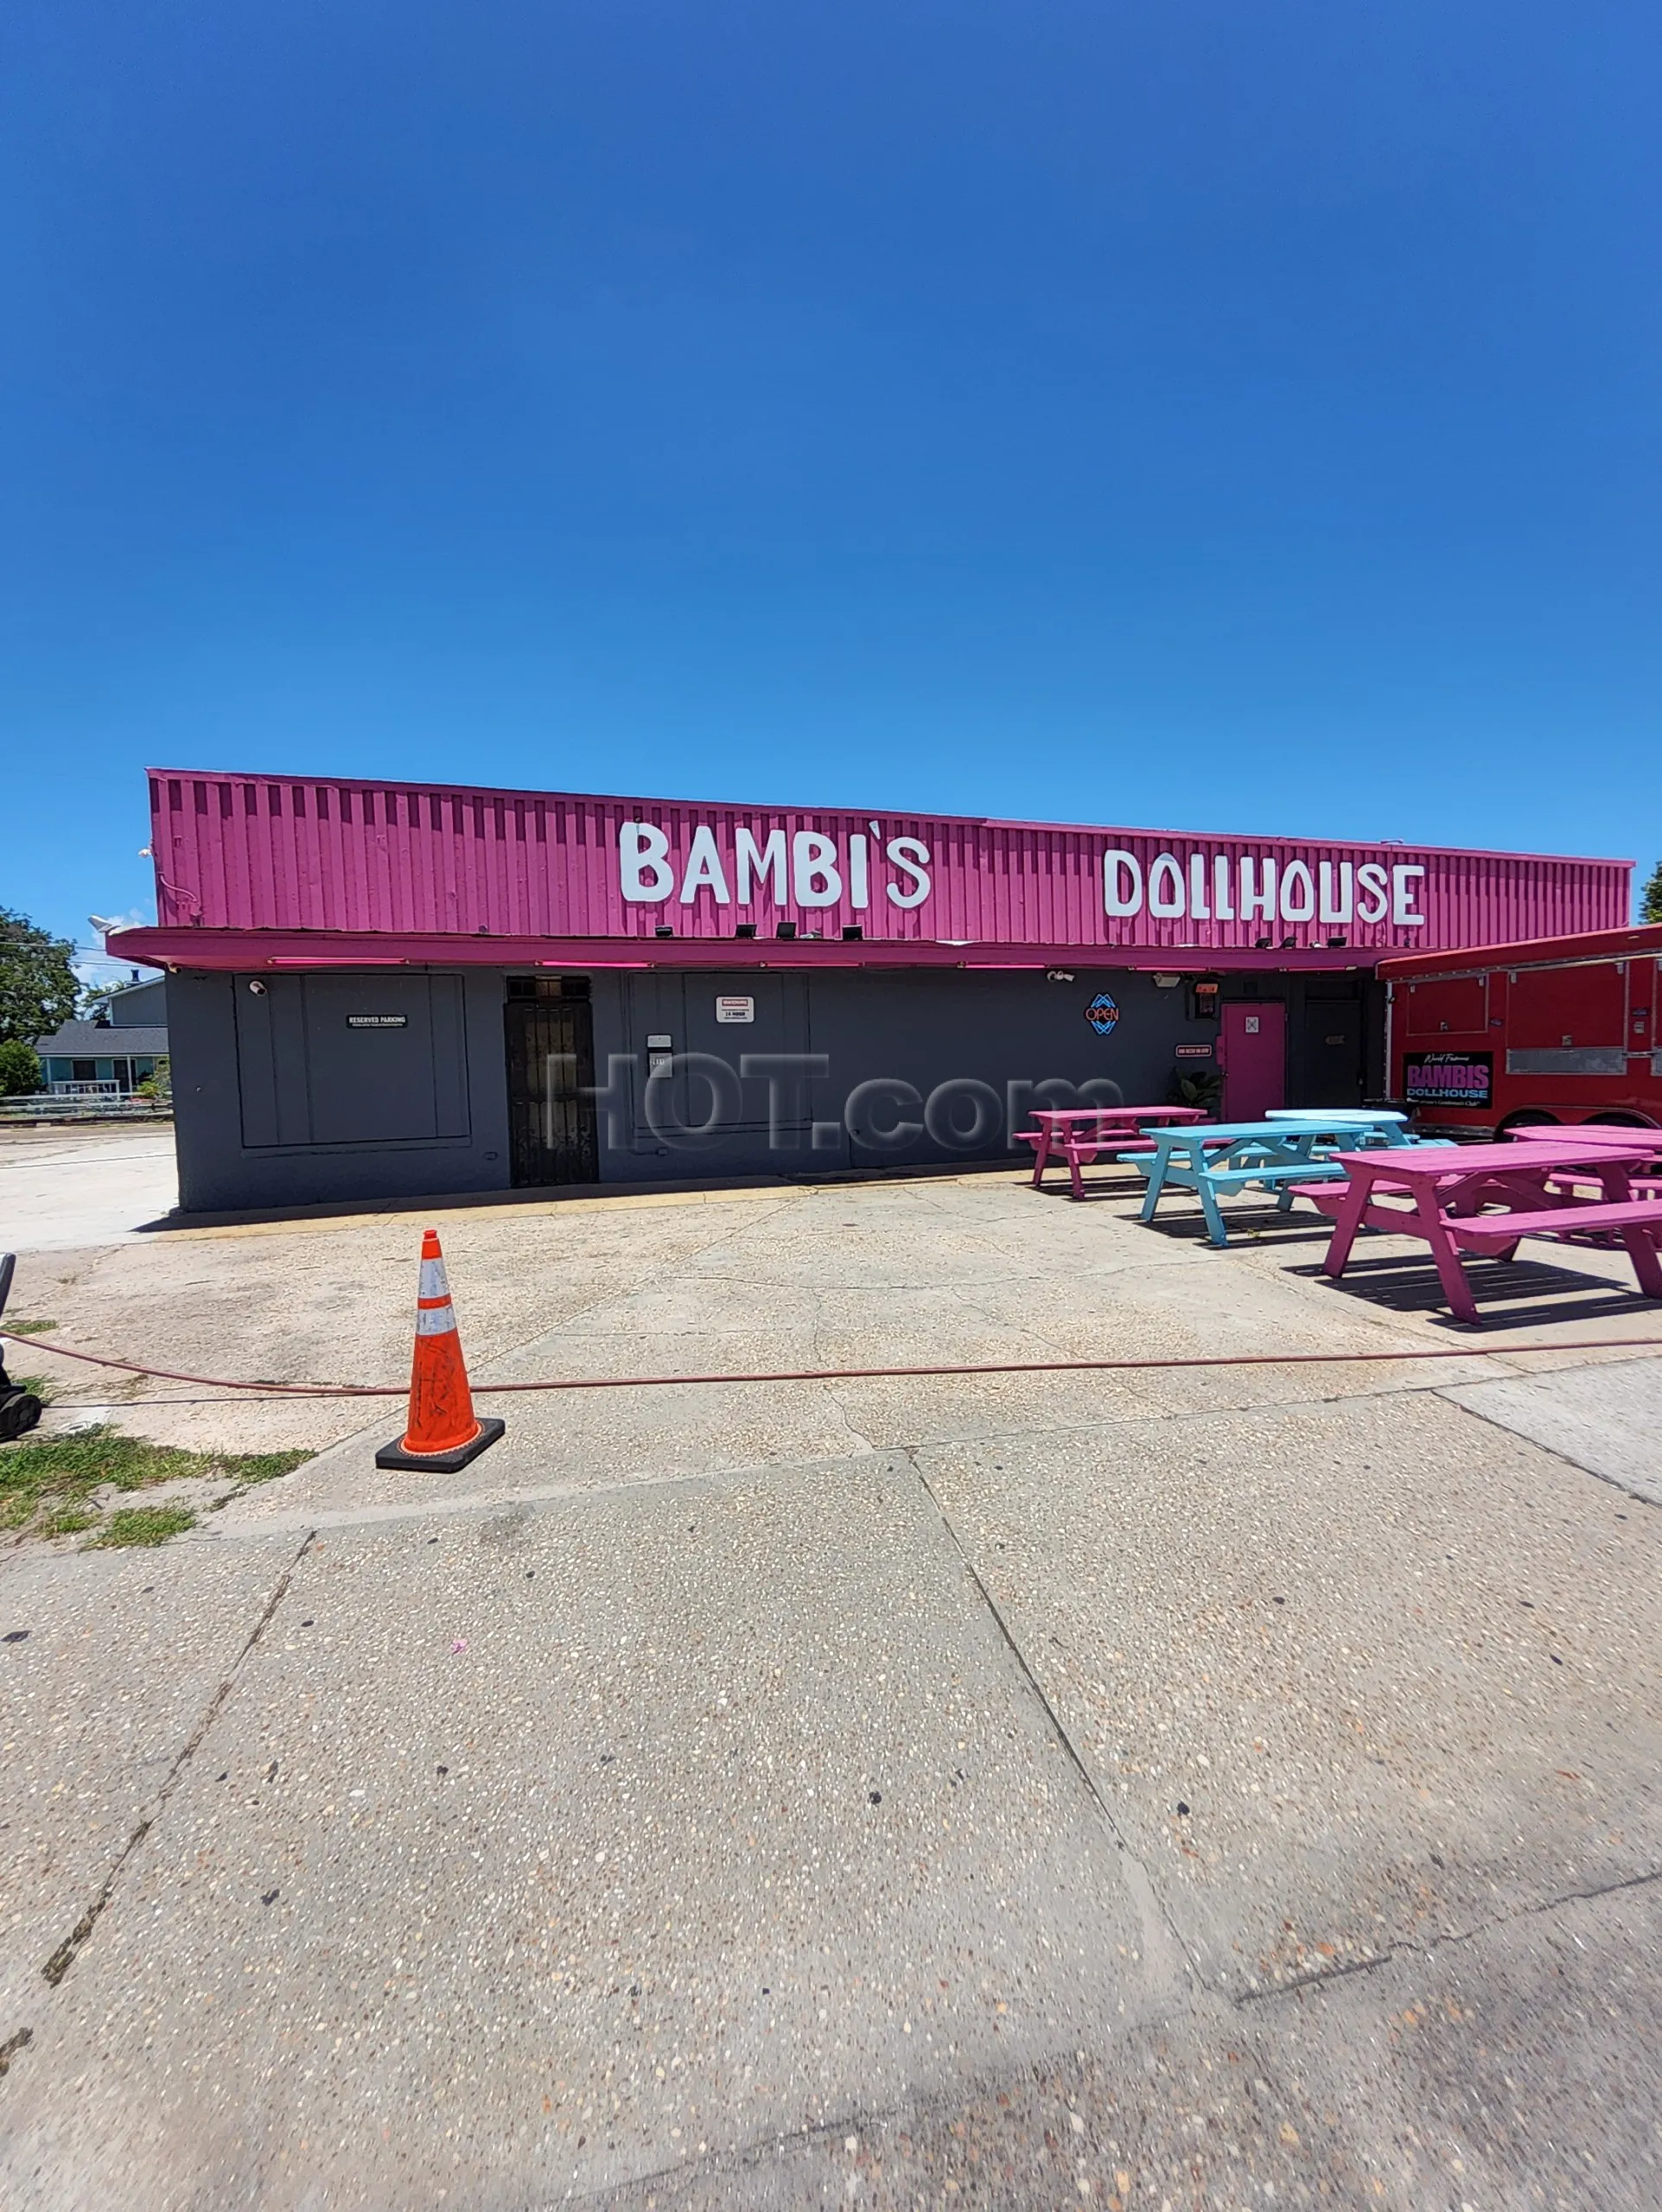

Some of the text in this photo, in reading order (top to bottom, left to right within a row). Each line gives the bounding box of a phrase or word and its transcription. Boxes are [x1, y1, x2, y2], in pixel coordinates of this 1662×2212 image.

[620, 820, 1424, 925] BAMBI'S DOLLHOUSE
[1086, 1007, 1119, 1020] OPEN
[1407, 1065, 1489, 1089] BAMBIS
[1406, 1089, 1488, 1098] DOLLHOUSE
